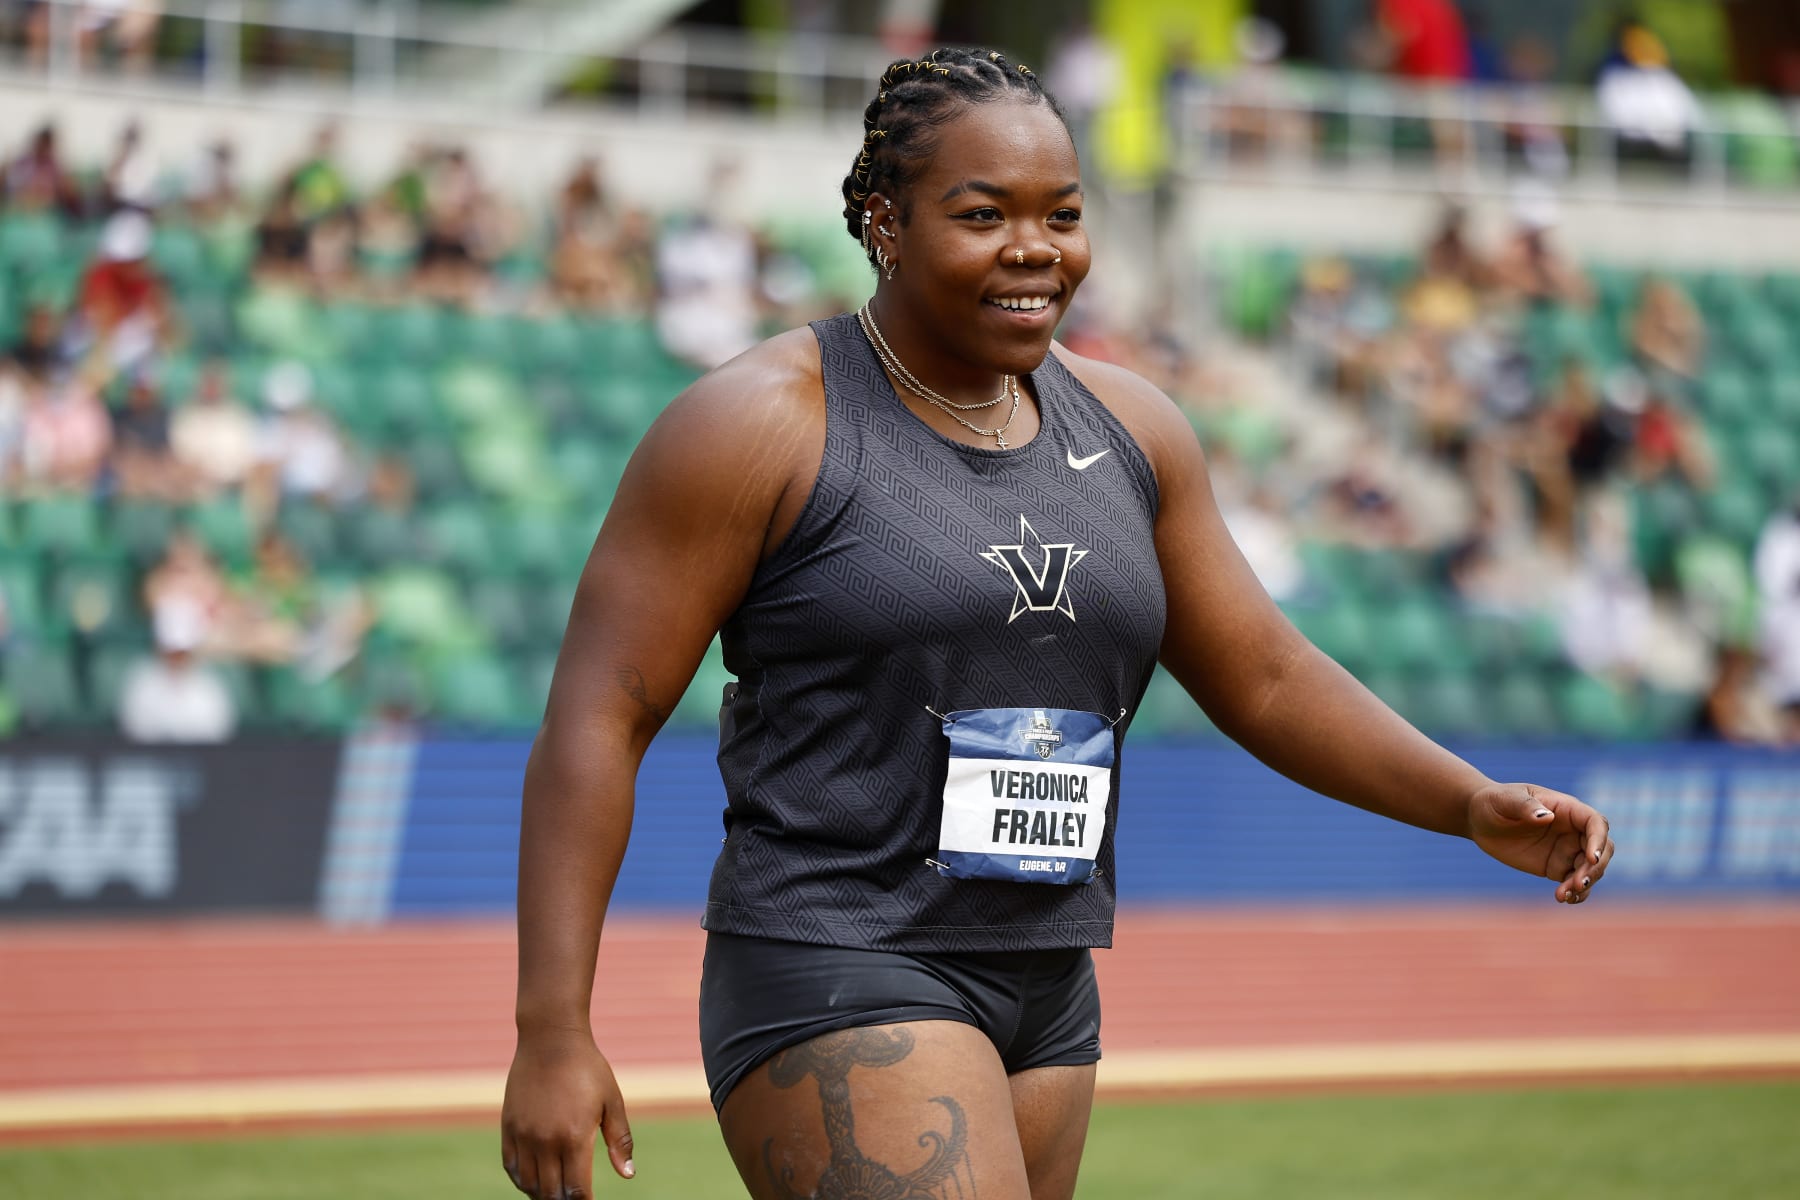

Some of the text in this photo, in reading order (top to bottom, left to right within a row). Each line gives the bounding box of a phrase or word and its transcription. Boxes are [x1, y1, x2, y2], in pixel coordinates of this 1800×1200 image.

[989, 543, 1075, 611] V
[990, 769, 1089, 804] VERONICA
[991, 808, 1087, 848] FRALEY
[1019, 859, 1053, 873] EUGENE,
